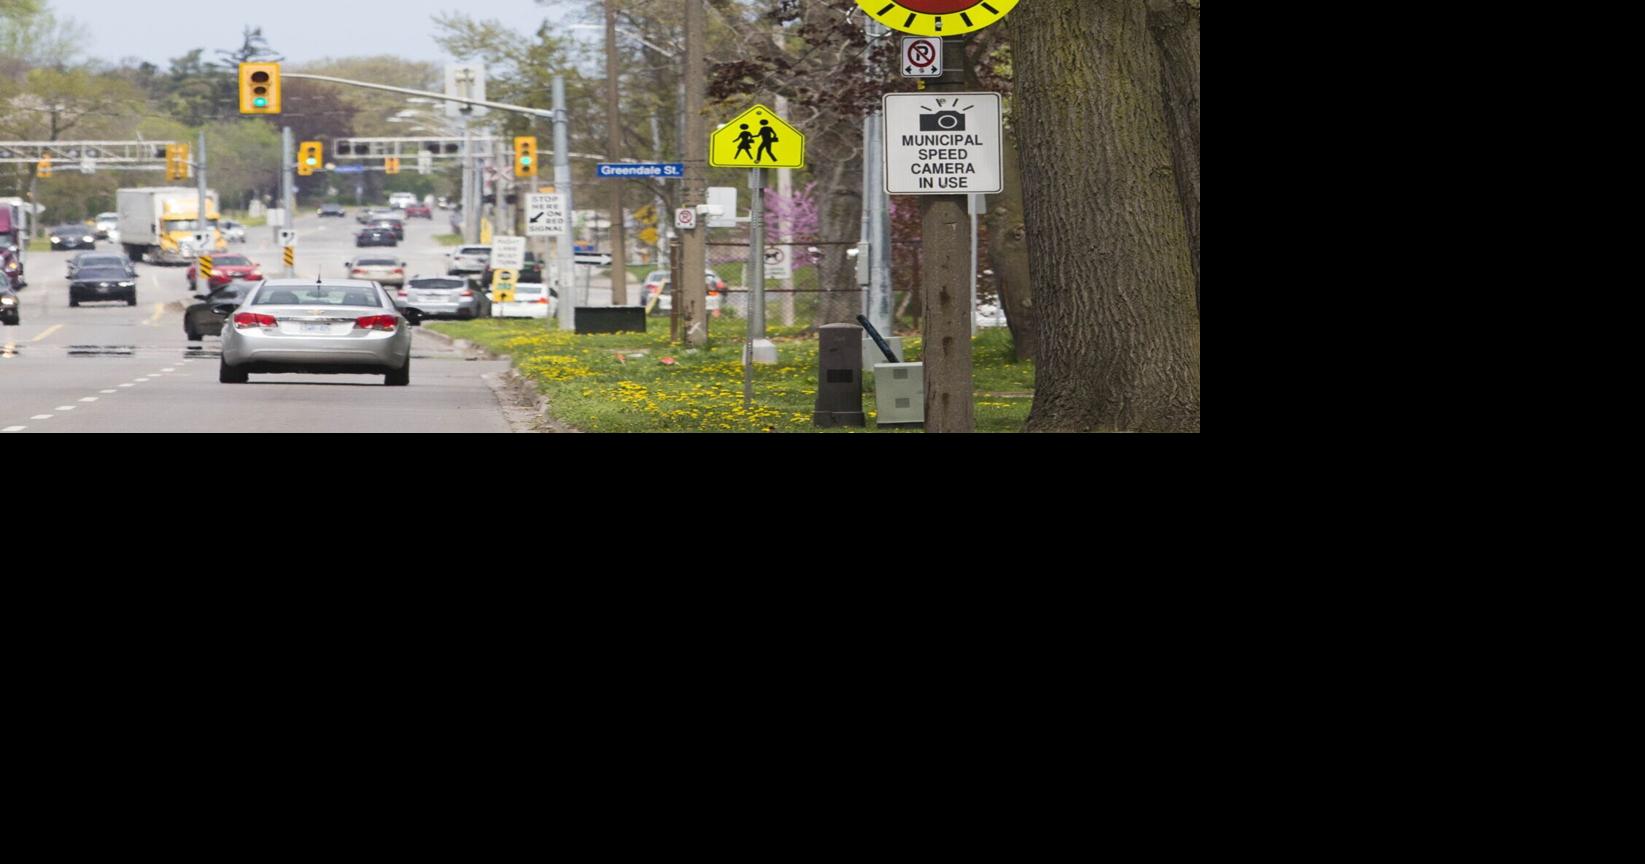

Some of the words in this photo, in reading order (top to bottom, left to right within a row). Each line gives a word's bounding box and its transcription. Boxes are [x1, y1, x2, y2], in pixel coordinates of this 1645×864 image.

[902, 134, 983, 146] MUNICIPAL
[918, 149, 968, 160] SPEED
[600, 165, 662, 175] Greendale
[663, 165, 680, 175] St.
[911, 163, 975, 174] CAMERA
[919, 177, 933, 188] IN
[938, 177, 968, 188] USE
